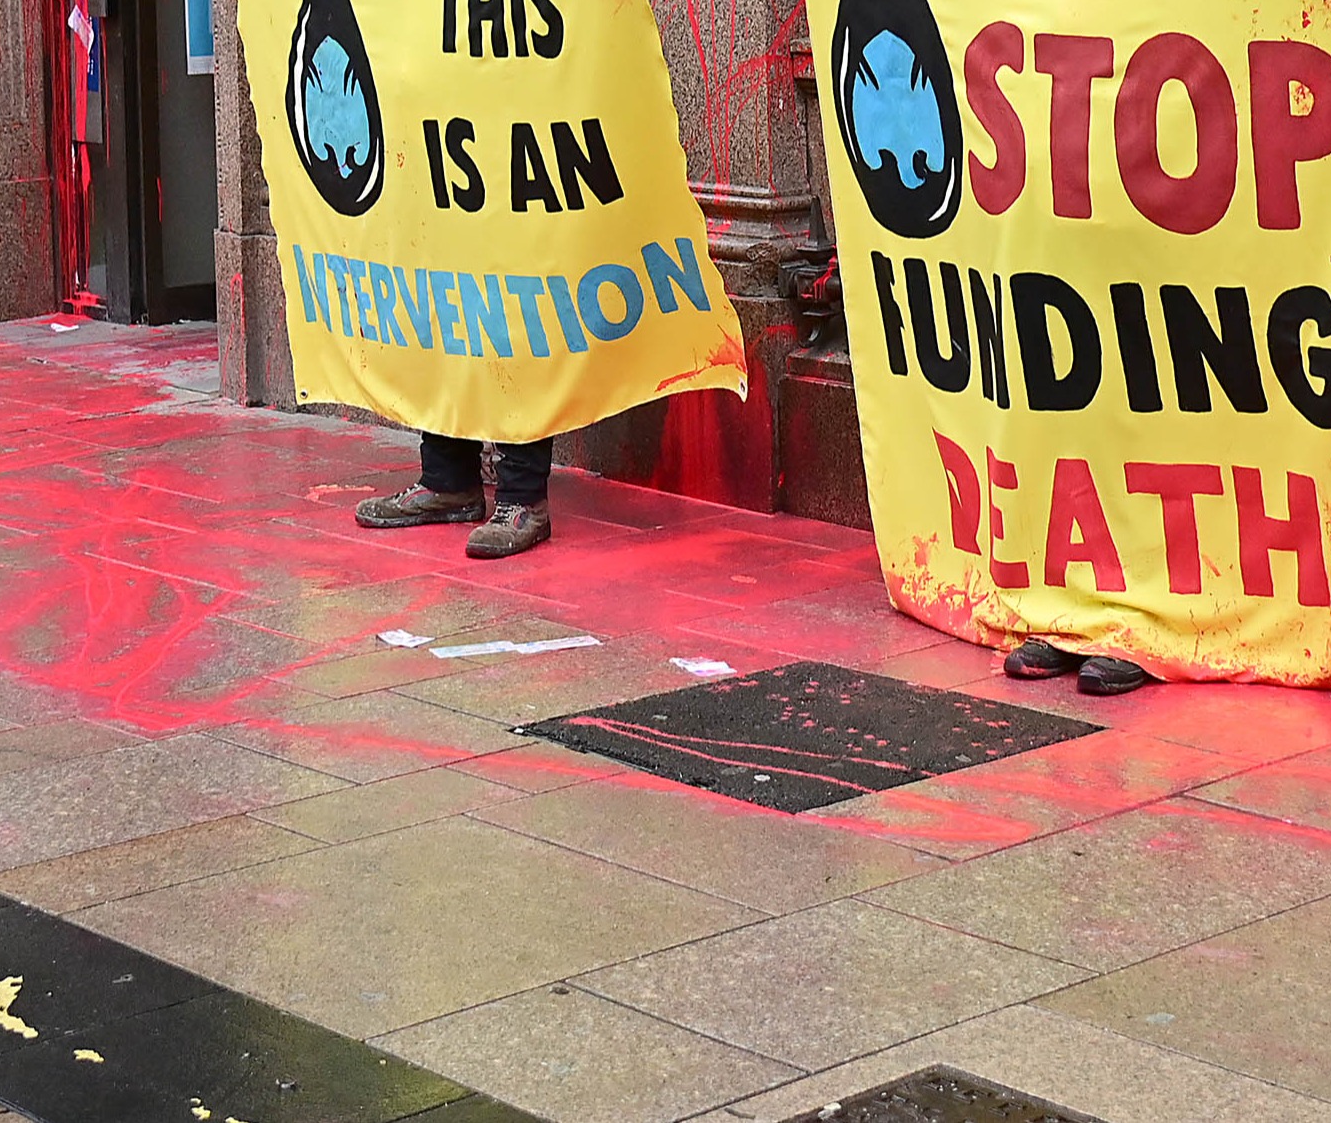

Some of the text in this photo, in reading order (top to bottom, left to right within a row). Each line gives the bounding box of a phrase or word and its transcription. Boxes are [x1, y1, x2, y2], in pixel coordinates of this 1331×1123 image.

[422, 117, 624, 212] IS AN
[293, 238, 711, 357] INTERVENTION
[932, 428, 1331, 607] DEATH
